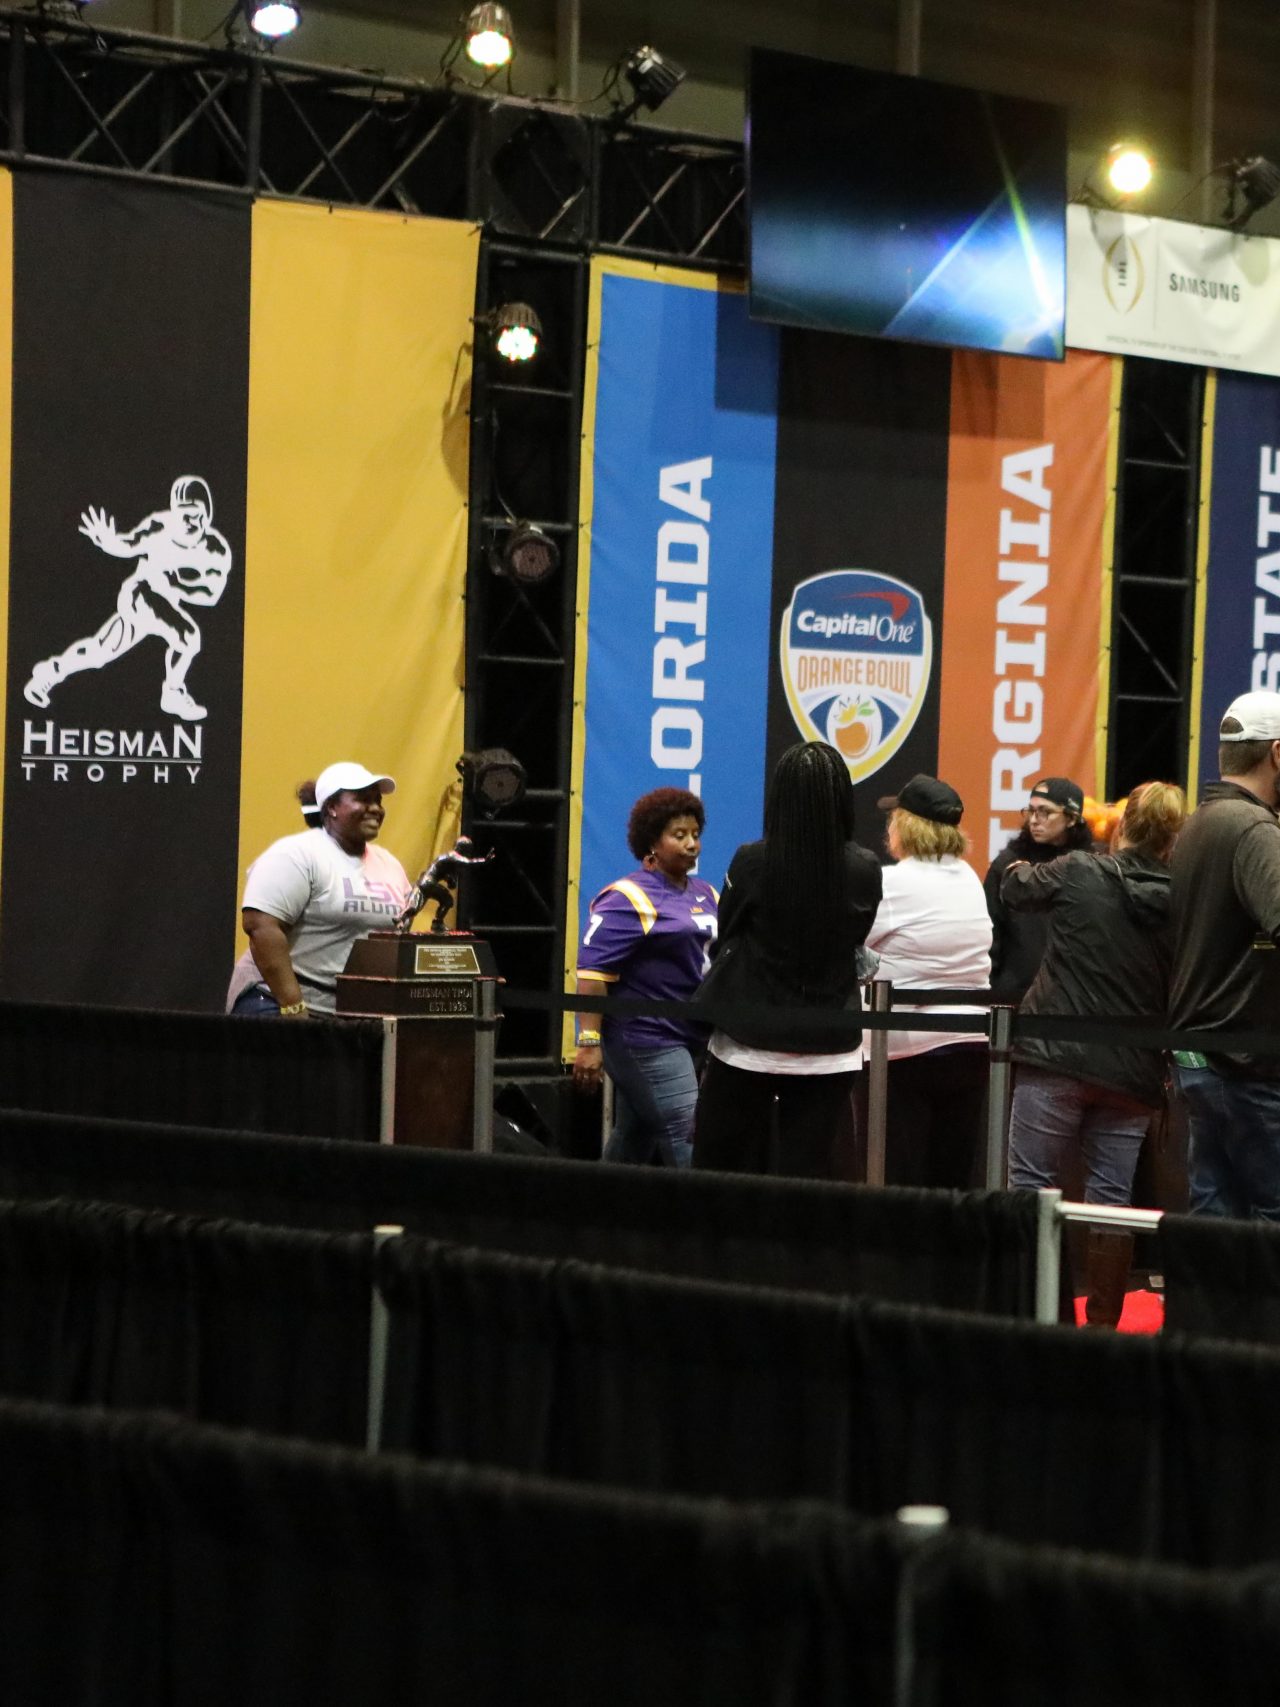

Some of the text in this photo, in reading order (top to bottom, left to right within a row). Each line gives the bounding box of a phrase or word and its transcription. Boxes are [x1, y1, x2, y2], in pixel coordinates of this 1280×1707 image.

[1169, 272, 1240, 303] SAMSUNG
[650, 456, 713, 875] ORIDA
[988, 443, 1055, 866] IRGINIA
[797, 655, 912, 698] ORANGE BOWL
[21, 762, 201, 785] TROPHY
[583, 914, 603, 945] 7
